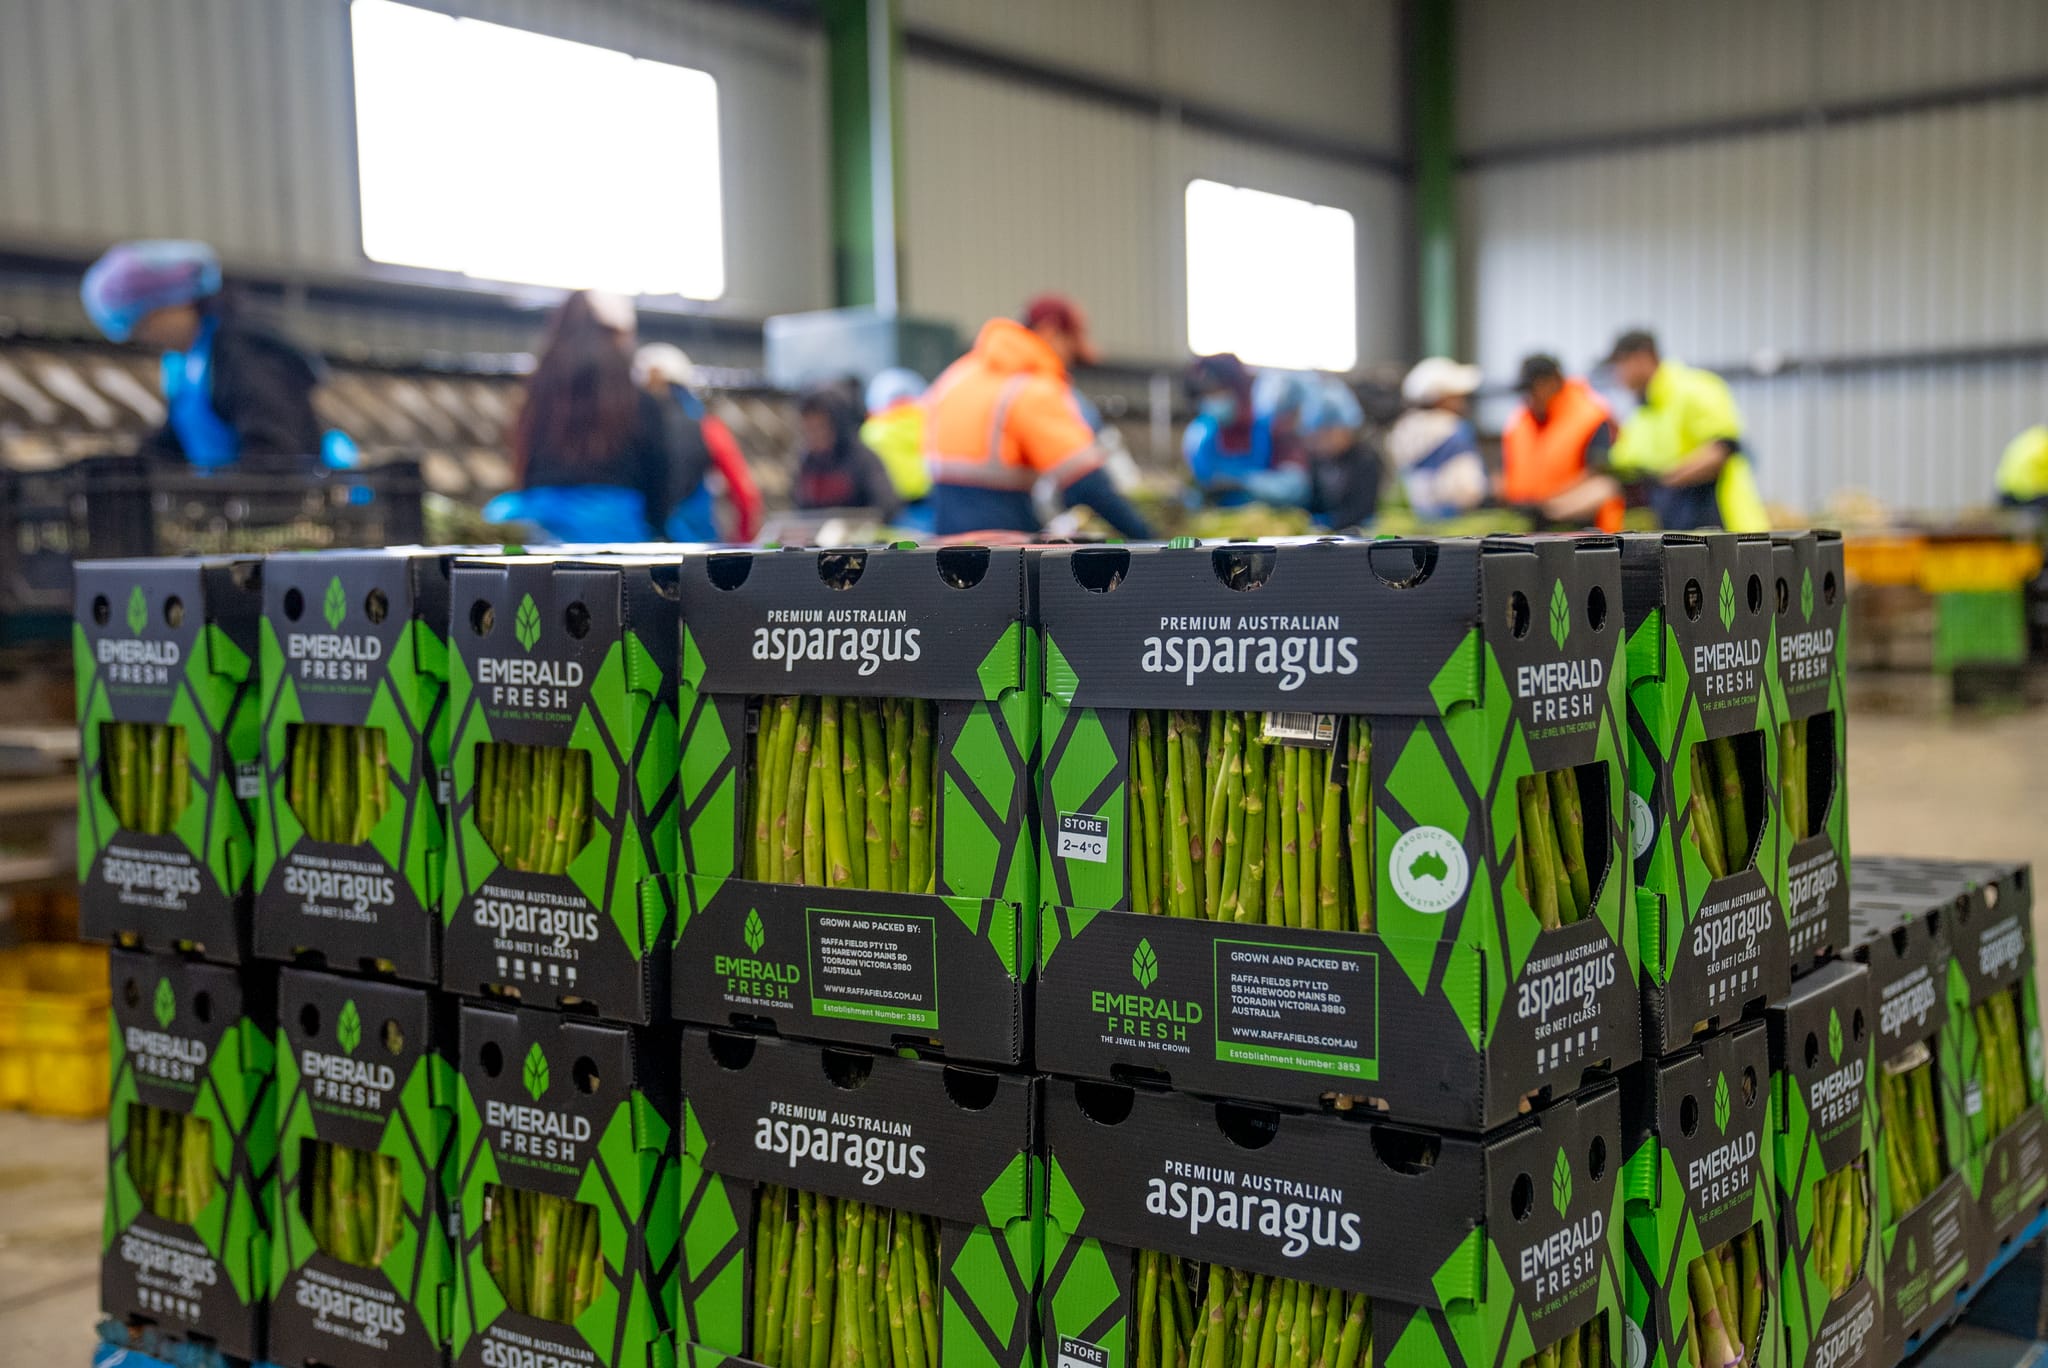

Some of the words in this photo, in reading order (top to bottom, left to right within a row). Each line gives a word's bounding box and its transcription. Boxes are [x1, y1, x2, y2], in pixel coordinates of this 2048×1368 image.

[768, 610, 823, 623] PREMIUM
[827, 610, 907, 623] AUSTRALIAN
[1160, 616, 1231, 631] PREMIUM
[1238, 616, 1339, 631] AUSTRALIAN
[98, 639, 180, 665] EMERALD
[288, 634, 381, 661] EMERALD
[752, 627, 921, 676] asparagus
[1694, 638, 1760, 674] EMERALD
[1780, 627, 1833, 662] EMERALD
[110, 664, 168, 684] FRESH
[301, 660, 368, 681] FRESH
[478, 658, 583, 687] EMERALD
[1142, 636, 1358, 691] asparagus
[1517, 658, 1602, 697] EMERALD
[1790, 655, 1827, 682] FRESH
[493, 686, 567, 708] FRESH
[1706, 670, 1753, 697] FRESH
[1533, 693, 1592, 723] FRESH
[1064, 818, 1101, 832] STORE
[1399, 831, 1442, 853] PRODUCT
[284, 866, 395, 913] asparagus
[482, 884, 524, 900] PREMIUM
[526, 891, 587, 908] AUSTRALIAN
[1404, 889, 1456, 907] AUSTRALIA
[1789, 859, 1838, 917] sparagus
[1701, 900, 1730, 919] PREMIUM
[1731, 887, 1767, 908] AUSTRALIAN
[474, 898, 599, 948] asparagus
[820, 917, 850, 928] GROWN
[872, 922, 905, 932] PACKED
[907, 925, 921, 933] BY:
[1693, 901, 1772, 961] asparagus
[821, 937, 843, 946] RAFFA
[845, 939, 868, 949] FIELDS
[831, 948, 872, 958] HAREWOOD
[874, 951, 896, 960] MAINS
[898, 953, 907, 961] RD
[1527, 953, 1563, 976] PREMIUM
[1565, 937, 1608, 963] AUSTRALIAN
[715, 955, 800, 984] EMERALD
[822, 956, 857, 966] TOORADIN
[859, 959, 892, 970] VICTORIA
[823, 966, 861, 976] AUSTRALIA
[1231, 952, 1269, 964] GROWN
[1272, 956, 1294, 966] AND
[1297, 958, 1339, 970] PACKED
[1342, 961, 1359, 971] BY:
[1707, 962, 1720, 976] 5KG
[1721, 956, 1733, 970] NET
[1737, 948, 1757, 964] CLASS
[728, 978, 788, 999] FRESH
[824, 985, 922, 1001] WWW.RAFFAFIELDS.COM.AU
[1231, 974, 1259, 984] RAFFA
[1261, 977, 1291, 987] FIELDS
[1293, 980, 1310, 989] PTY
[1312, 982, 1329, 991] LTD
[1231, 985, 1242, 993] 65
[1244, 986, 1296, 998] HAREWOOD
[1298, 991, 1327, 1001] MAINS
[1328, 994, 1341, 1003] RD
[1518, 952, 1615, 1023] asparagus
[823, 1004, 873, 1016] Establishment
[875, 1010, 905, 1020] Number:
[1092, 990, 1203, 1024] EMERALD
[1232, 995, 1276, 1007] TOORADIN
[1278, 1000, 1320, 1012] VICTORIA
[1322, 1004, 1346, 1015] 3980
[1232, 1006, 1280, 1018] AUSTRALIA
[1108, 1017, 1186, 1041] FRESH
[1535, 1023, 1551, 1040] 5KG
[1553, 1017, 1567, 1033] NET
[1573, 1006, 1596, 1025] CLASS
[127, 1026, 208, 1066] EMERALD
[1101, 1035, 1114, 1044] THE
[1115, 1037, 1137, 1047] JEWEL
[1138, 1039, 1147, 1048] IN
[1148, 1041, 1161, 1050] THE
[1162, 1043, 1190, 1054] CROWN
[1232, 1027, 1358, 1049] WWW.RAFFAFIELDS.COM.AU
[137, 1054, 195, 1082] FRESH
[303, 1050, 395, 1092] EMERALD
[1230, 1050, 1293, 1064] Establishment
[1296, 1057, 1335, 1069] Number:
[1338, 1062, 1360, 1072] 3853
[314, 1078, 381, 1110] FRESH
[1811, 1058, 1864, 1111] EMERALD
[486, 1099, 591, 1142] EMERALD
[770, 1101, 827, 1123] PREMIUM
[831, 1112, 912, 1138] AUSTRALIAN
[1821, 1088, 1860, 1128] FRESH
[501, 1130, 575, 1162] FRESH
[755, 1117, 927, 1186] asparagus
[1689, 1131, 1755, 1191] EMERALD
[1164, 1159, 1236, 1186] PREMIUM
[1241, 1173, 1343, 1205] AUSTRALIAN
[1701, 1164, 1749, 1208] FRESH
[1145, 1177, 1362, 1258] asparagus
[1520, 1210, 1603, 1283] EMERALD
[1536, 1248, 1594, 1303] FRESH
[296, 1279, 406, 1337] asparagus
[490, 1326, 532, 1347] PREMIUM
[533, 1338, 594, 1362] AUSTRALIAN
[1064, 1342, 1102, 1362] STORE
